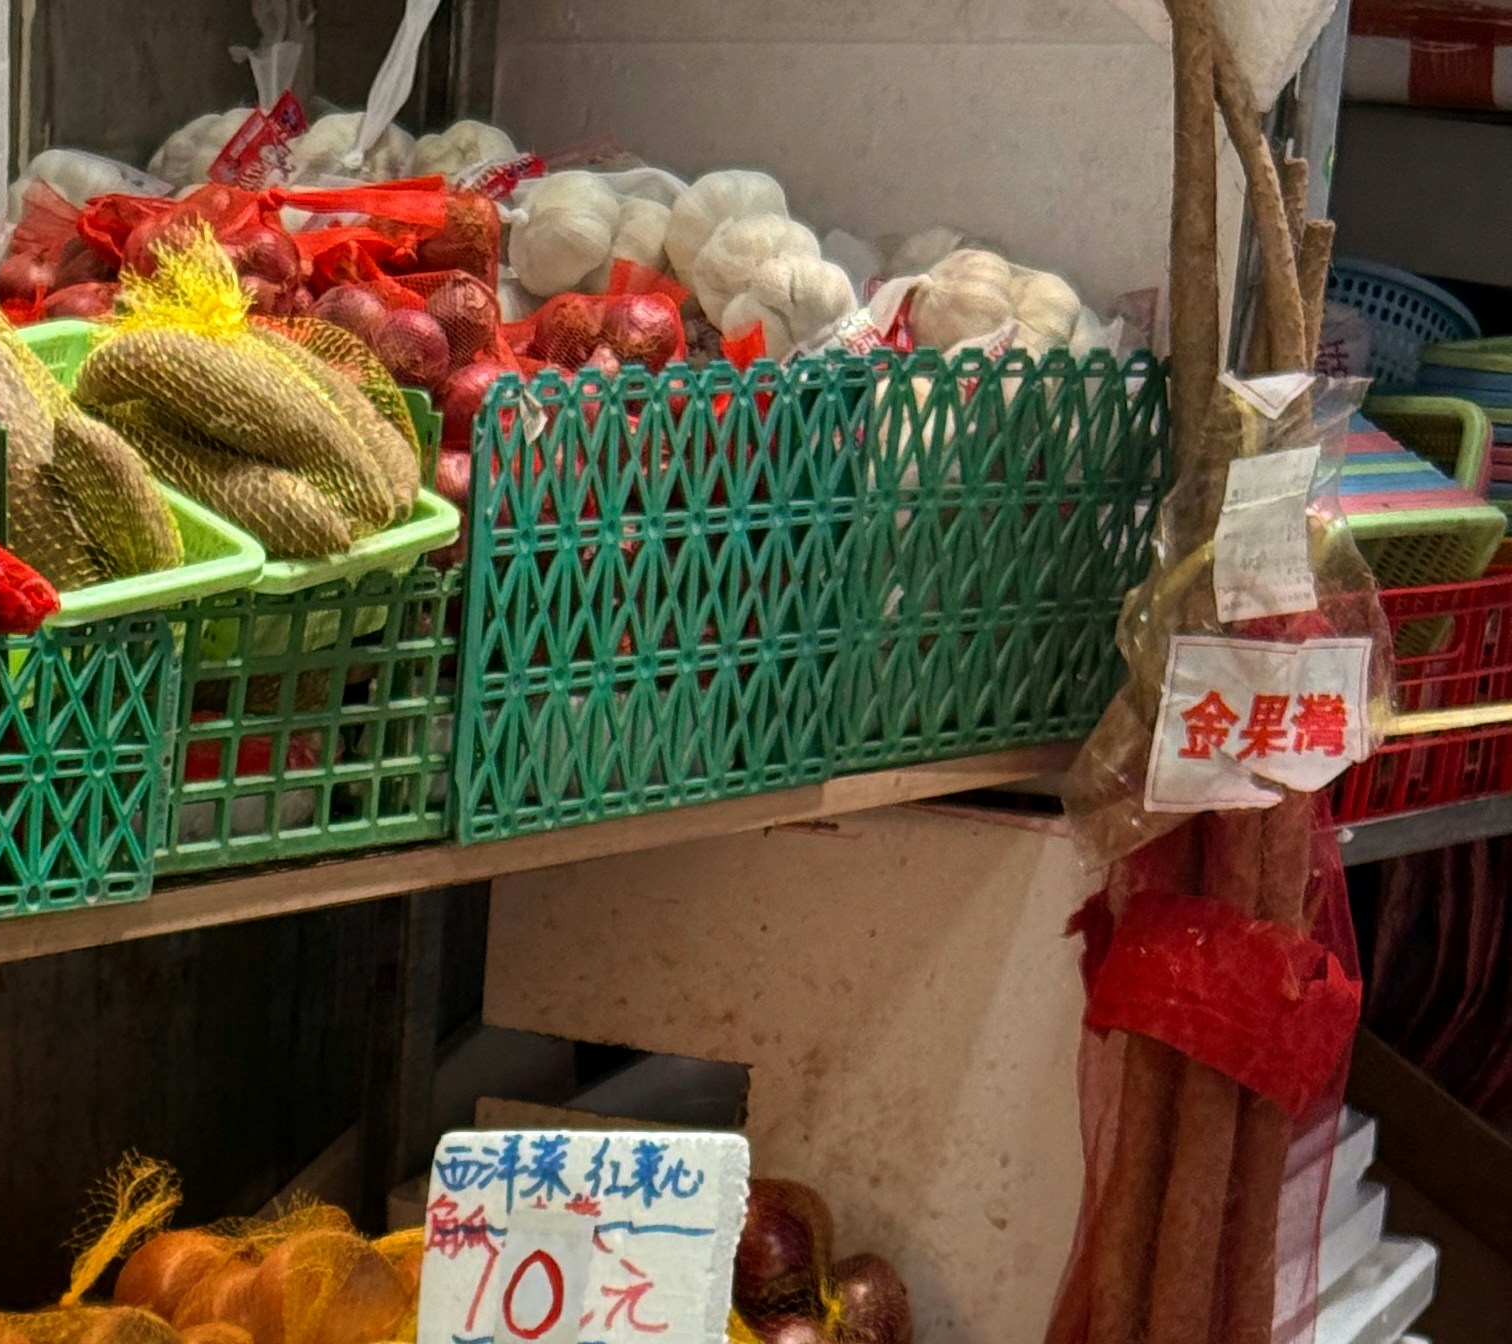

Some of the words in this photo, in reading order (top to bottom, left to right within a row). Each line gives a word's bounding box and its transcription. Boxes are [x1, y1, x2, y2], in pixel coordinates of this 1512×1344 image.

[1177, 690, 1349, 761] 金果灣
[434, 1133, 572, 1216] 西洋菜
